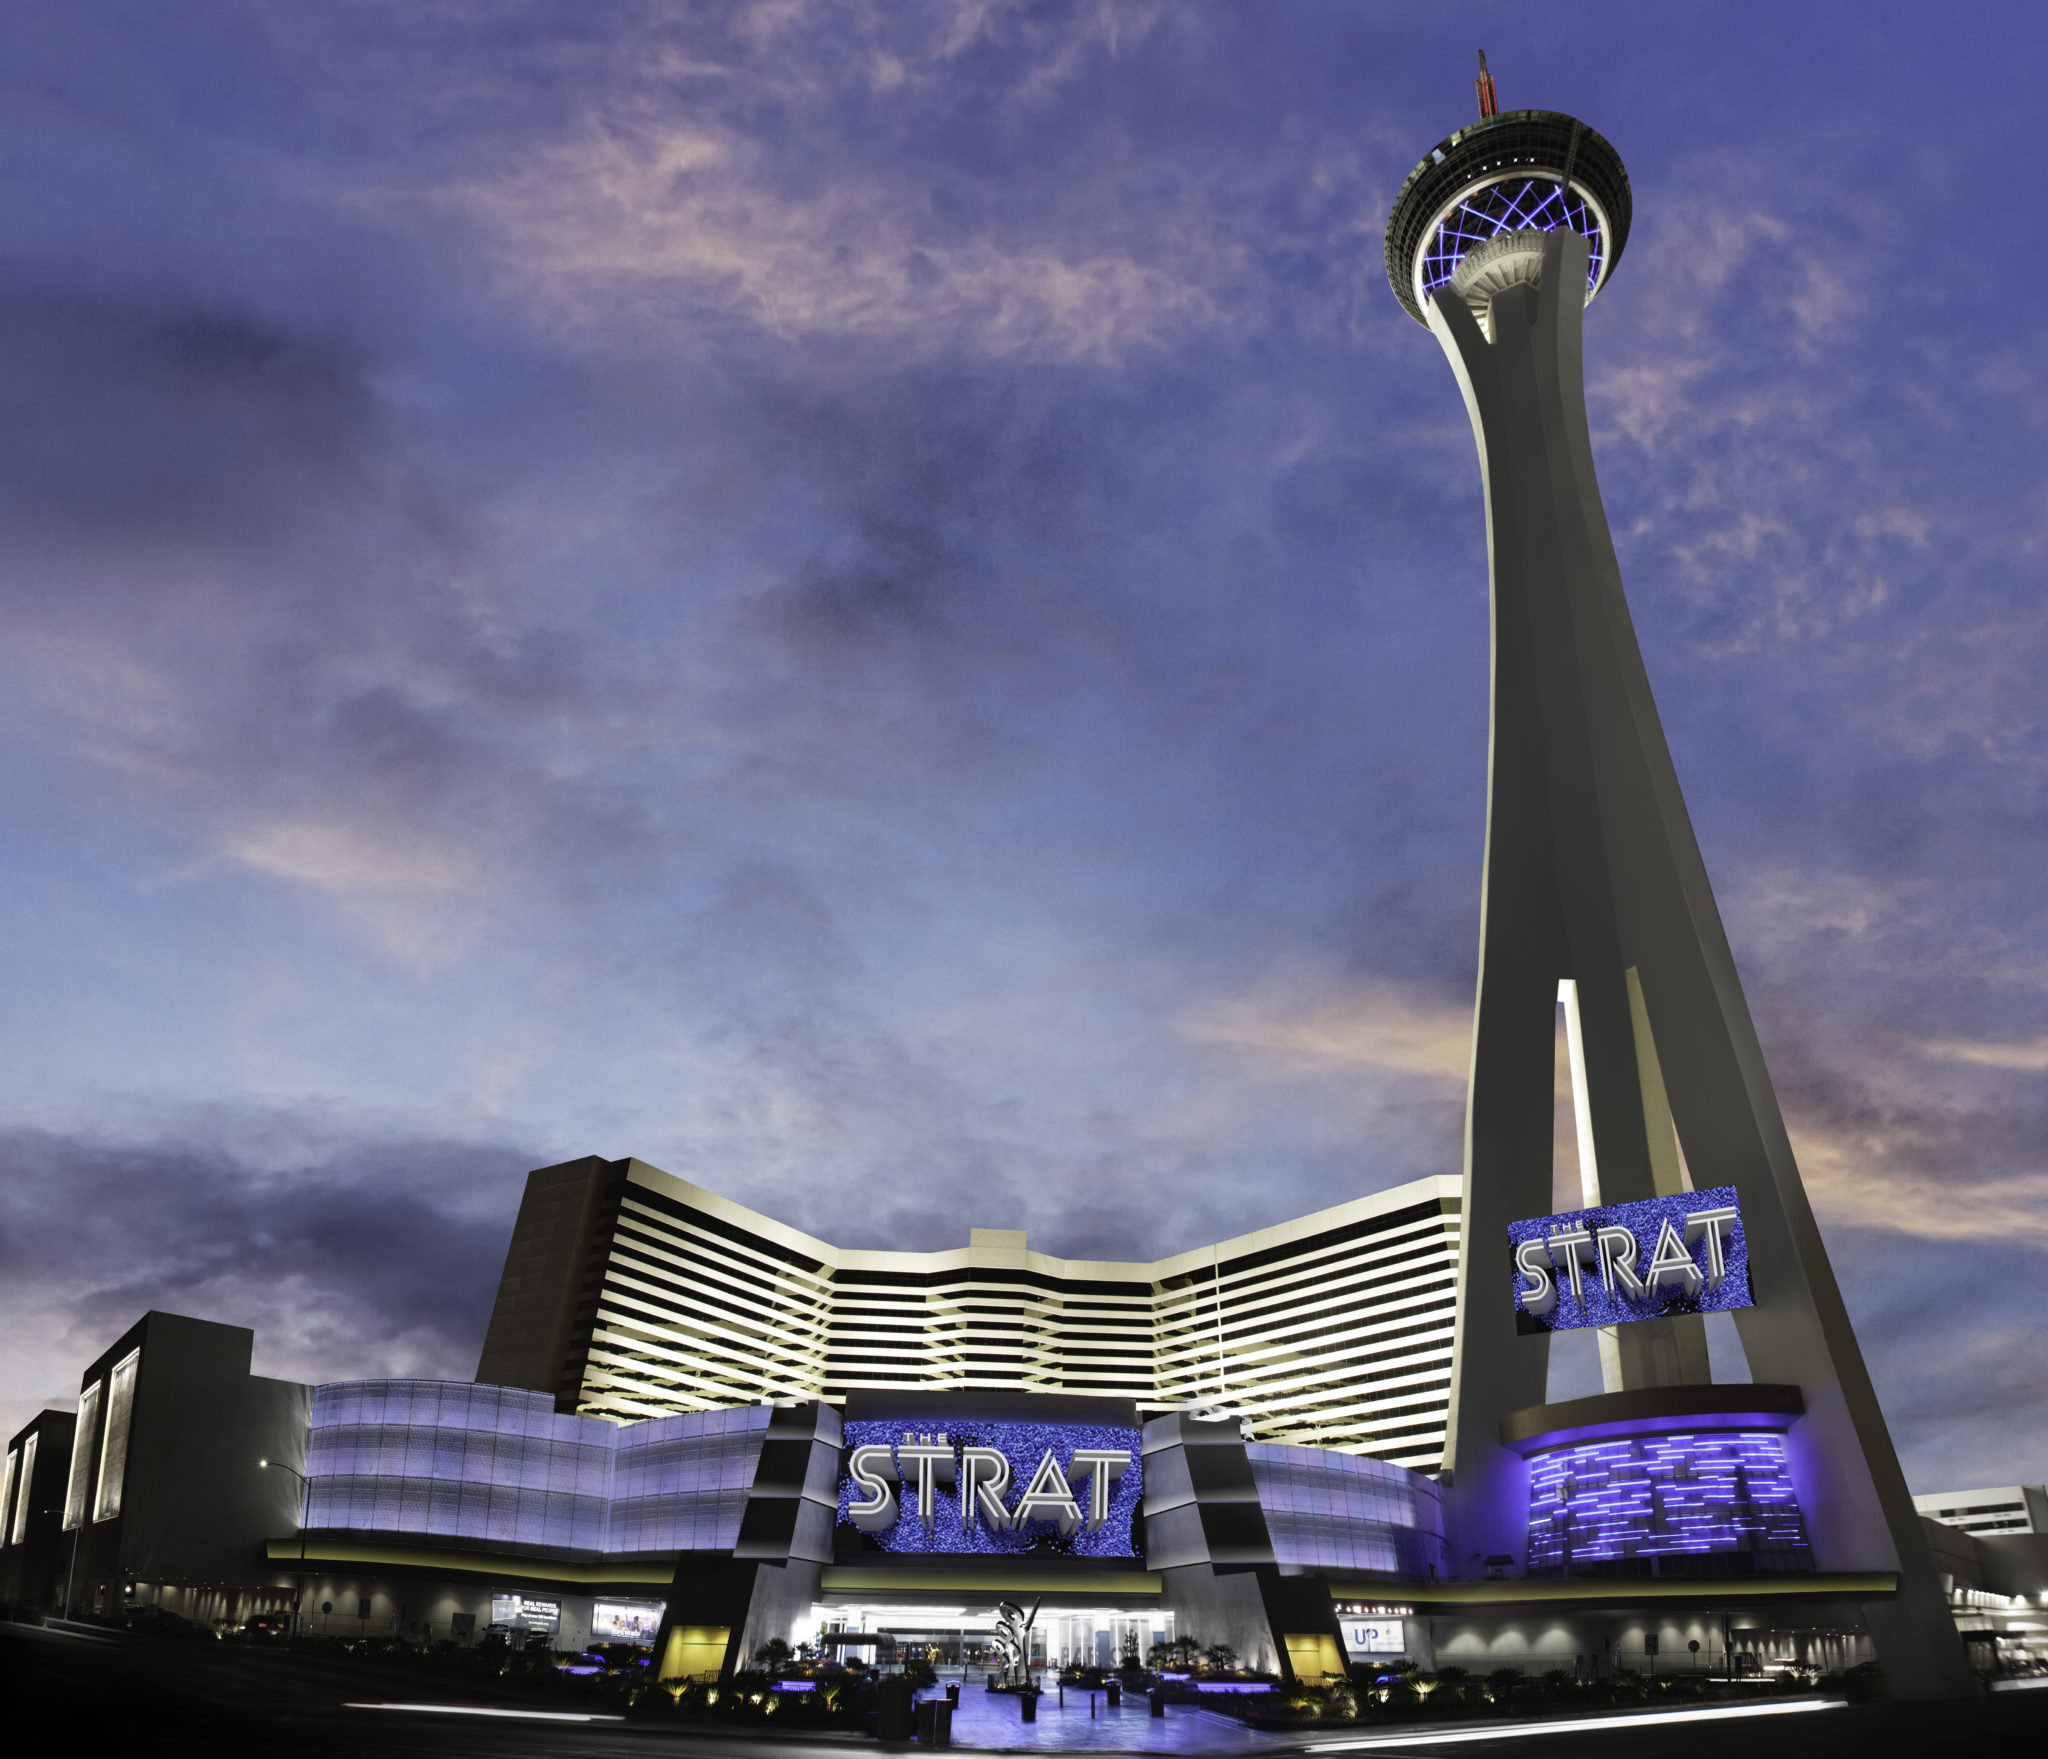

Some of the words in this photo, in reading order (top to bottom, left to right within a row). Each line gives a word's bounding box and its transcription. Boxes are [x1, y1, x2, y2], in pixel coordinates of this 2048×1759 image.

[1550, 1219, 1584, 1234] THE
[1516, 1206, 1737, 1303] STRAT
[903, 1432, 947, 1443] THE
[849, 1445, 1132, 1524] STRAT
